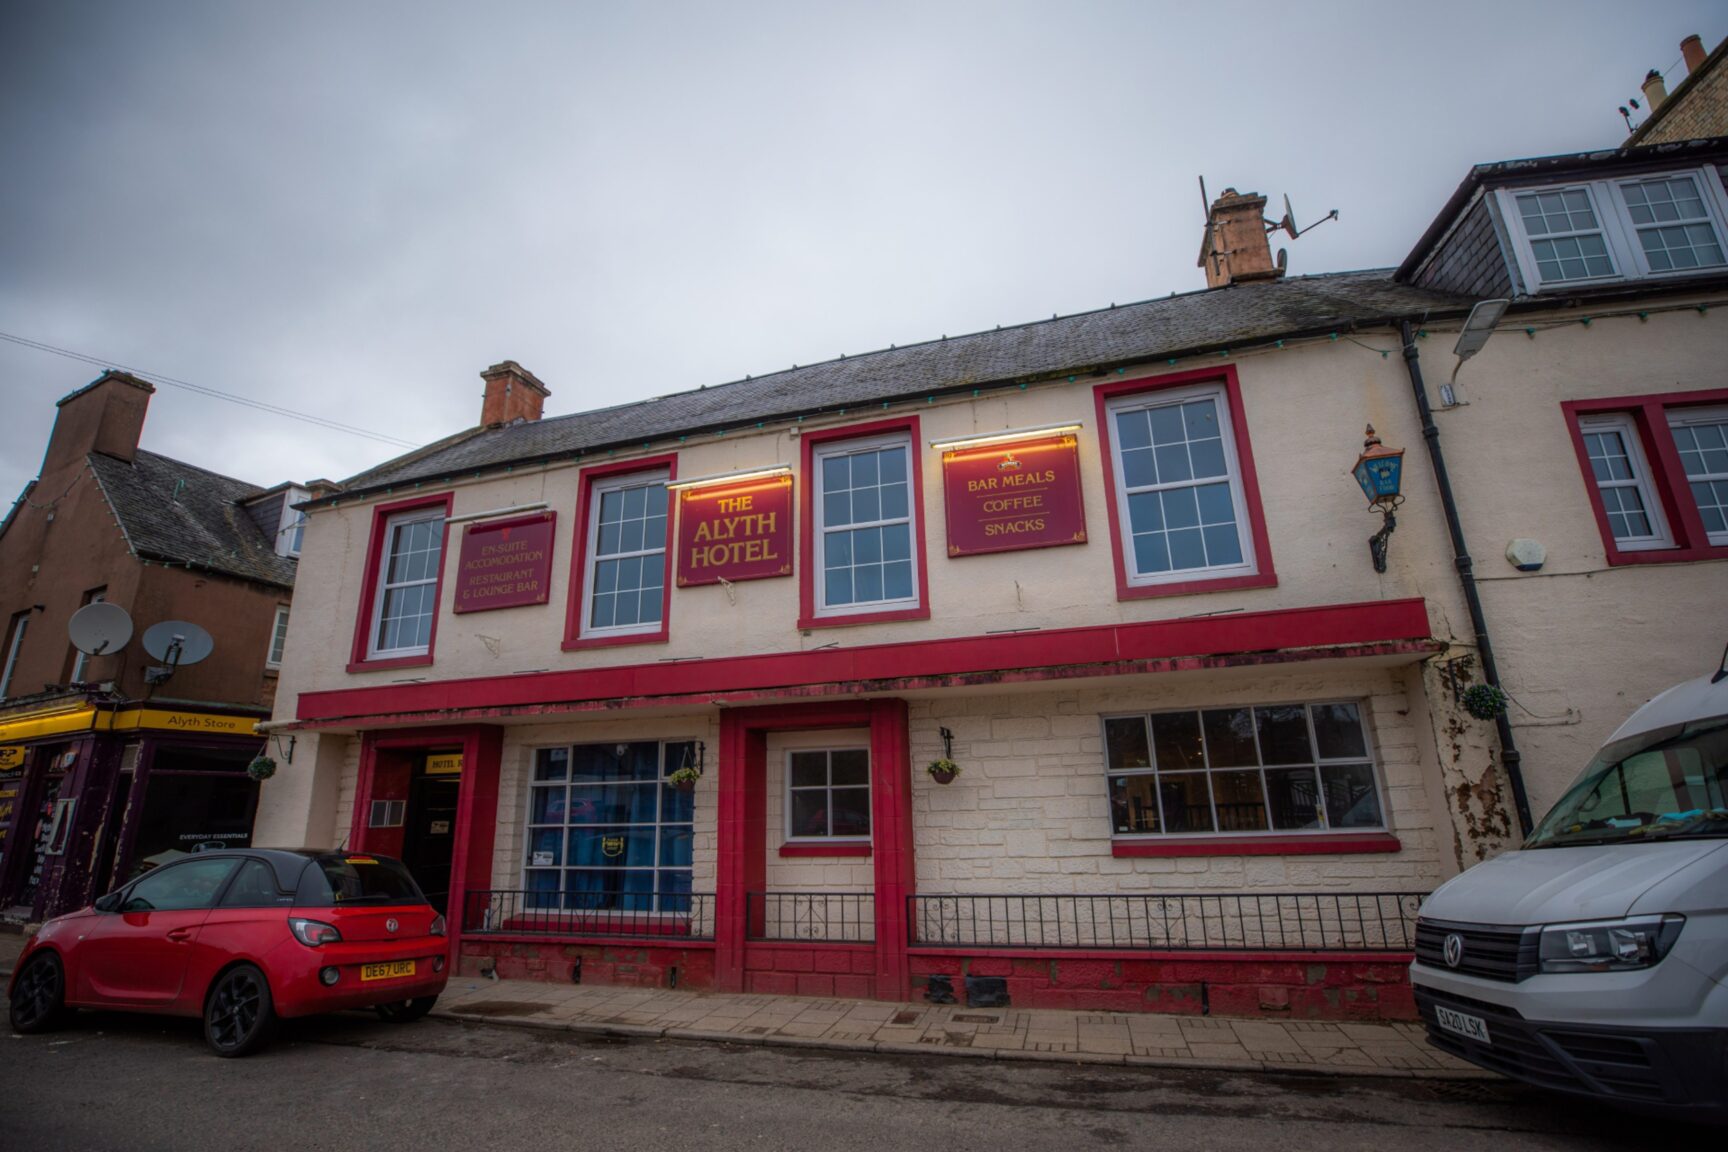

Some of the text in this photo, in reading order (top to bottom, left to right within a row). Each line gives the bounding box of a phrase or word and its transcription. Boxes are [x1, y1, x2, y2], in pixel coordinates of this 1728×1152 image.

[967, 470, 1056, 492] BAR MEALS
[718, 495, 753, 513] THE
[983, 495, 1044, 513] COFFEE
[693, 512, 777, 543] ALYTH
[985, 518, 1045, 536] SNACKS
[690, 539, 778, 569] HOTEL
[469, 568, 535, 585] RESTAURANT
[473, 583, 515, 598] LOUNGE
[516, 580, 539, 592] BAR
[167, 715, 236, 729] Alyth Store
[365, 961, 412, 978] DE67 URC
